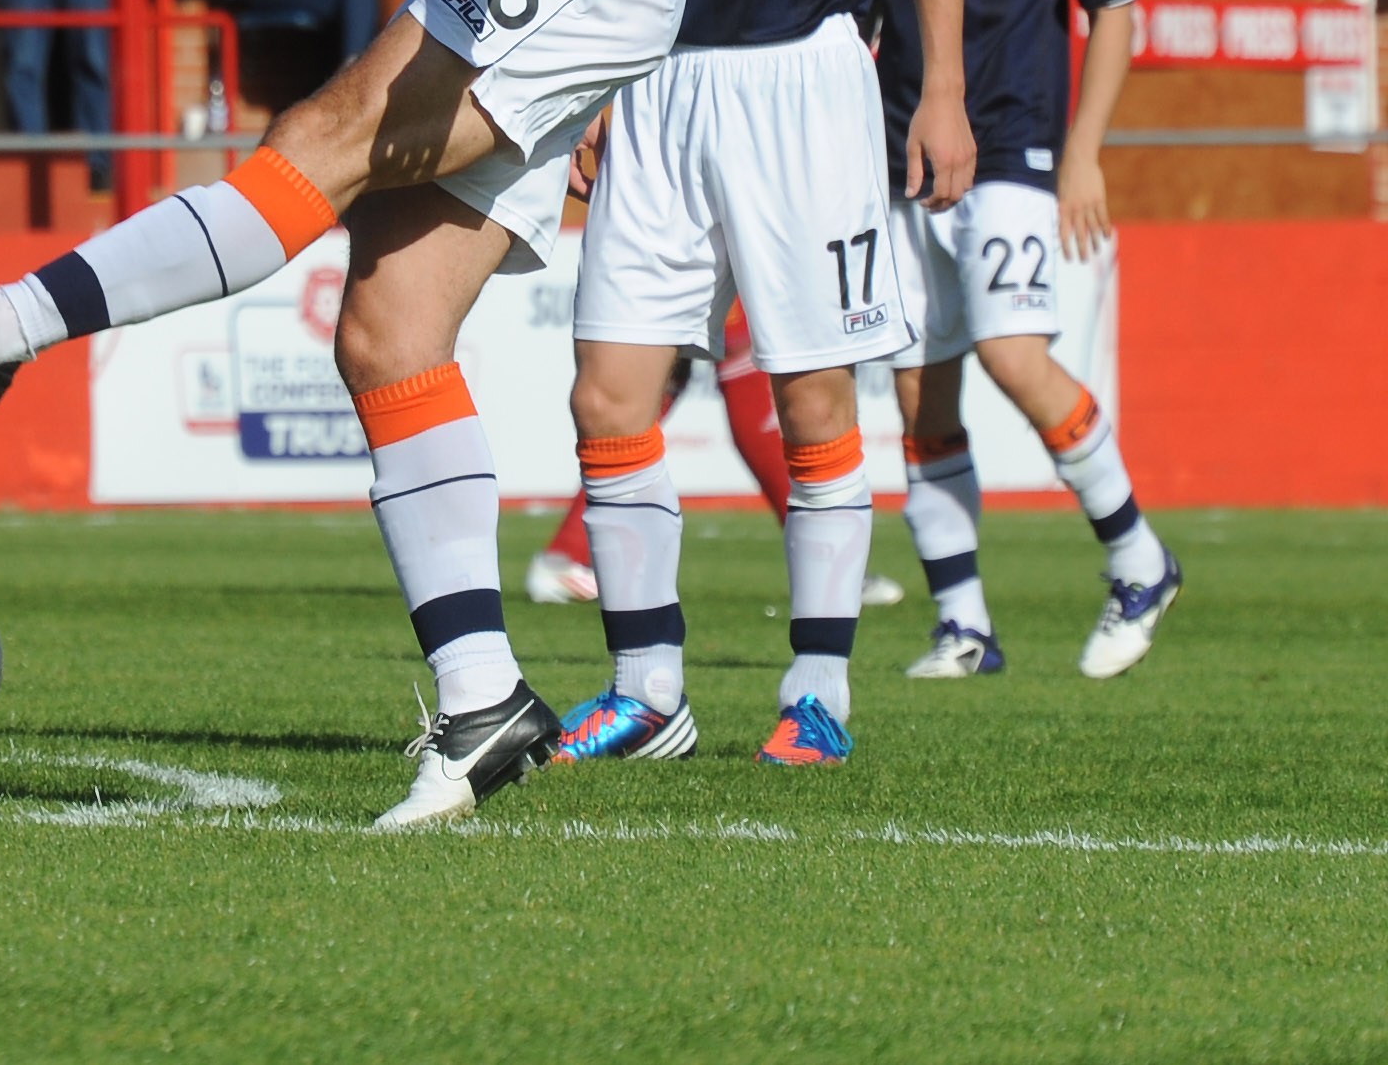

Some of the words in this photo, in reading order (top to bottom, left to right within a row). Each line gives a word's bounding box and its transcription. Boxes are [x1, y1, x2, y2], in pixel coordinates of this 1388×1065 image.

[826, 228, 878, 311] 17
[981, 235, 1050, 294] 22
[850, 309, 884, 331] FILA
[265, 414, 367, 456] TRUS
